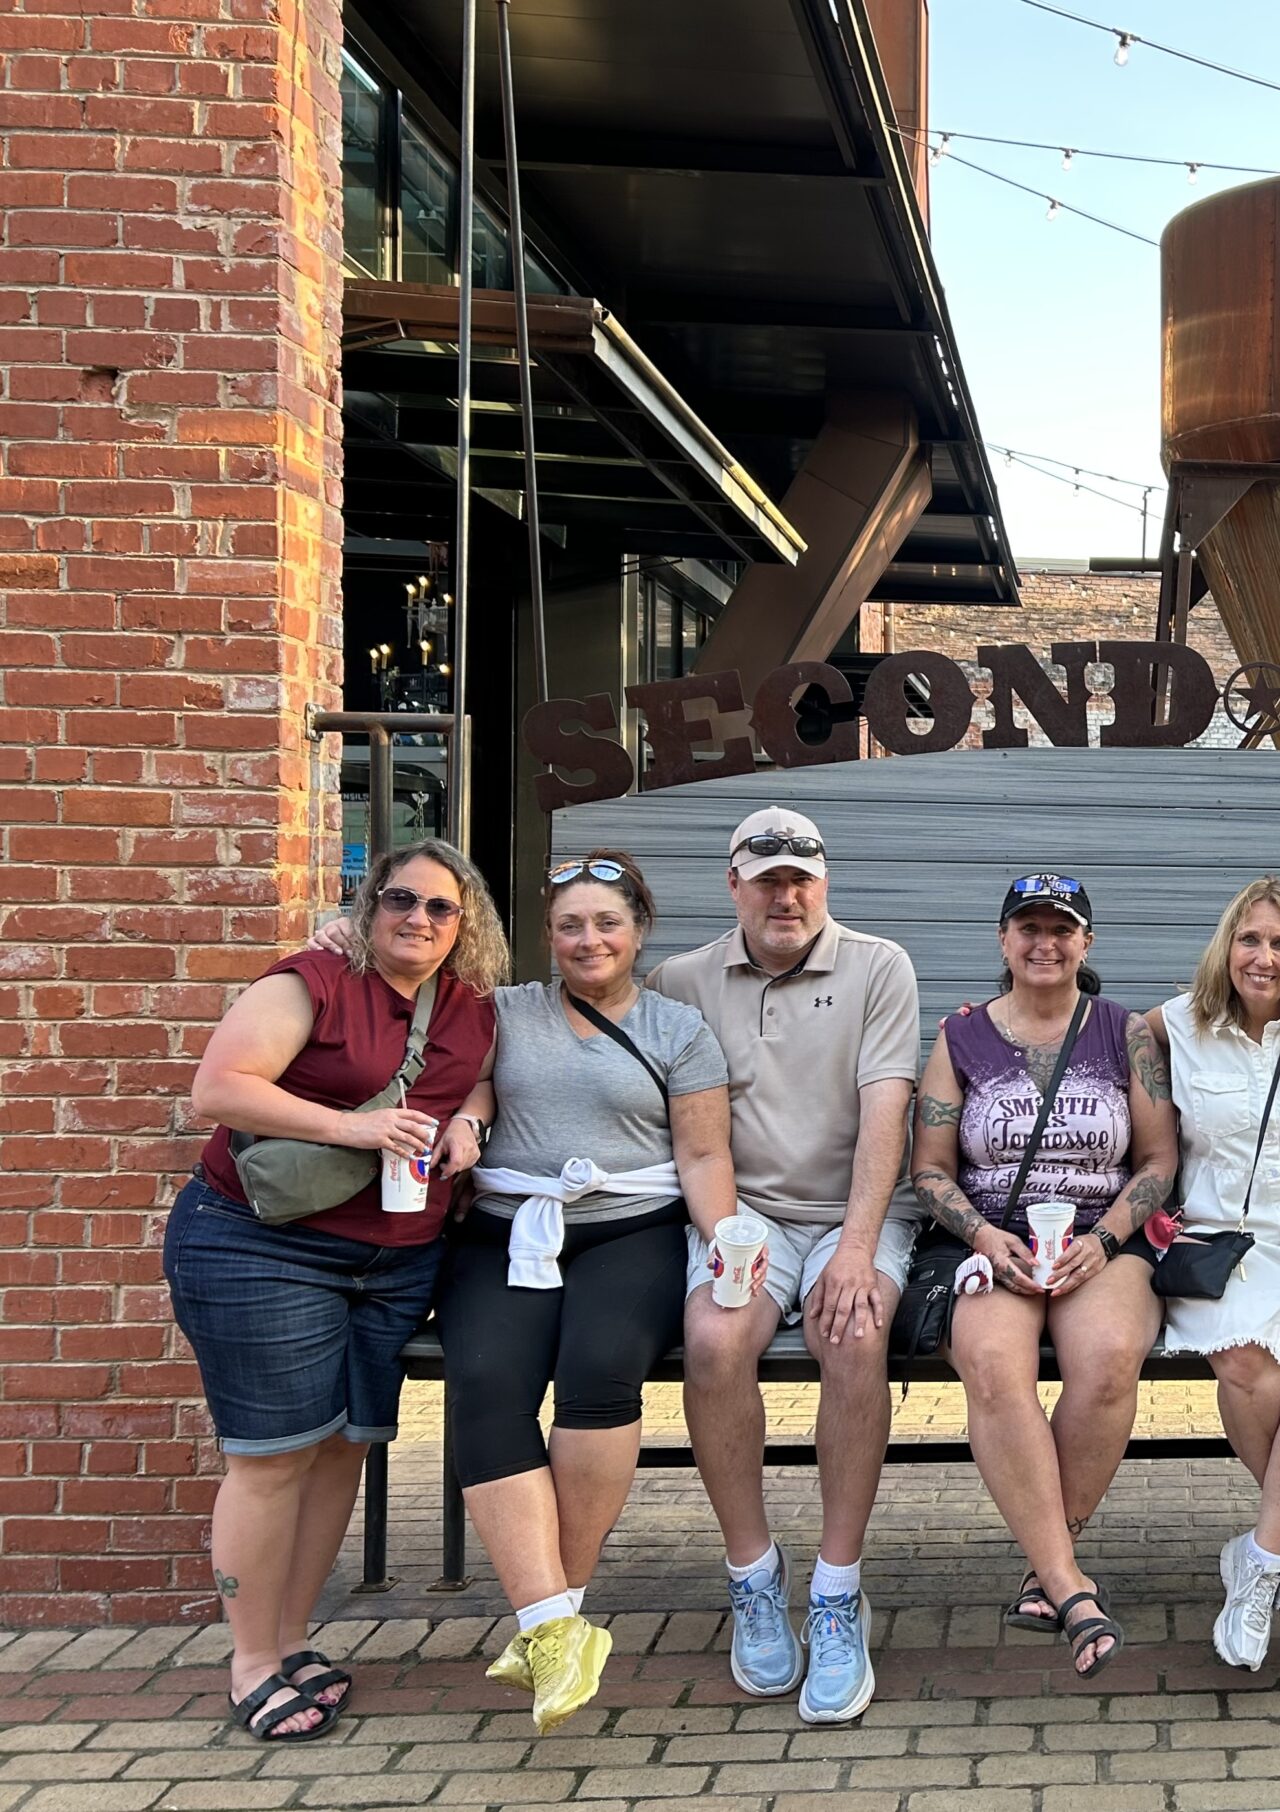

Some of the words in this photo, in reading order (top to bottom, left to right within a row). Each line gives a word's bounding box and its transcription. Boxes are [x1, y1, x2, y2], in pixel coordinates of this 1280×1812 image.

[521, 641, 1218, 812] SECOND
[998, 1097, 1099, 1117] SMOTH
[1028, 1163, 1069, 1175] WEET
